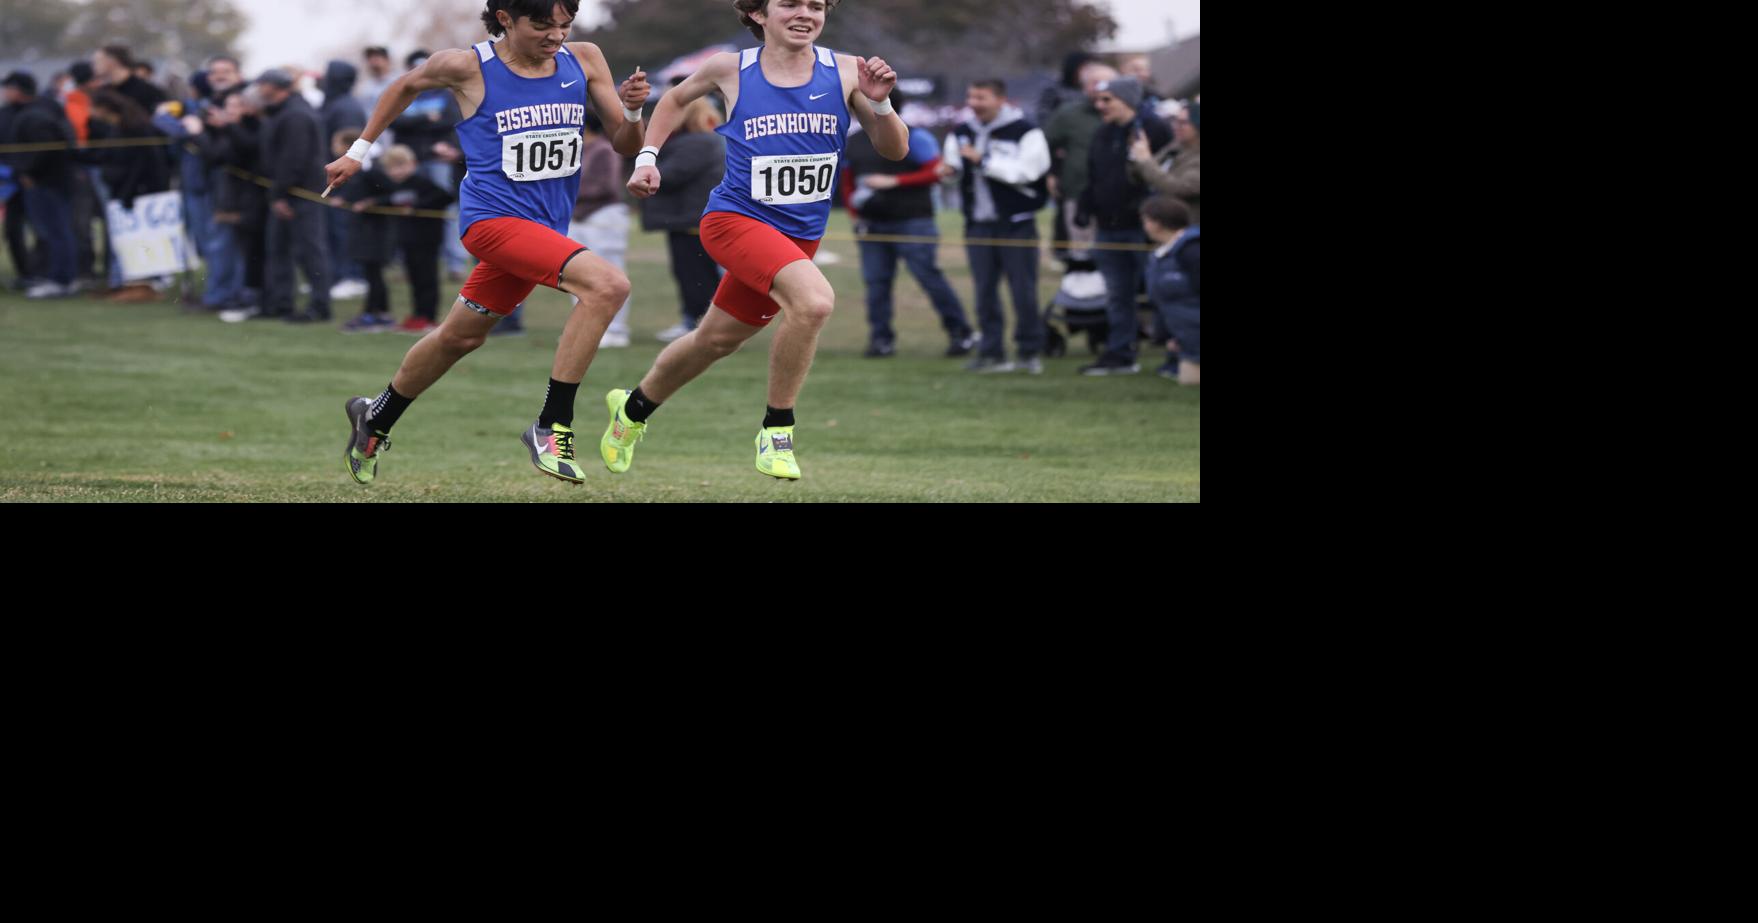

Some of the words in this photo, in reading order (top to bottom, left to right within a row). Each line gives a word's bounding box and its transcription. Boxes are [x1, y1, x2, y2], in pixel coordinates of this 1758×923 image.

[496, 103, 584, 133] EISENHOWER
[744, 113, 837, 140] EISENHOWER
[511, 138, 577, 172] 1051
[760, 164, 833, 196] 1050
